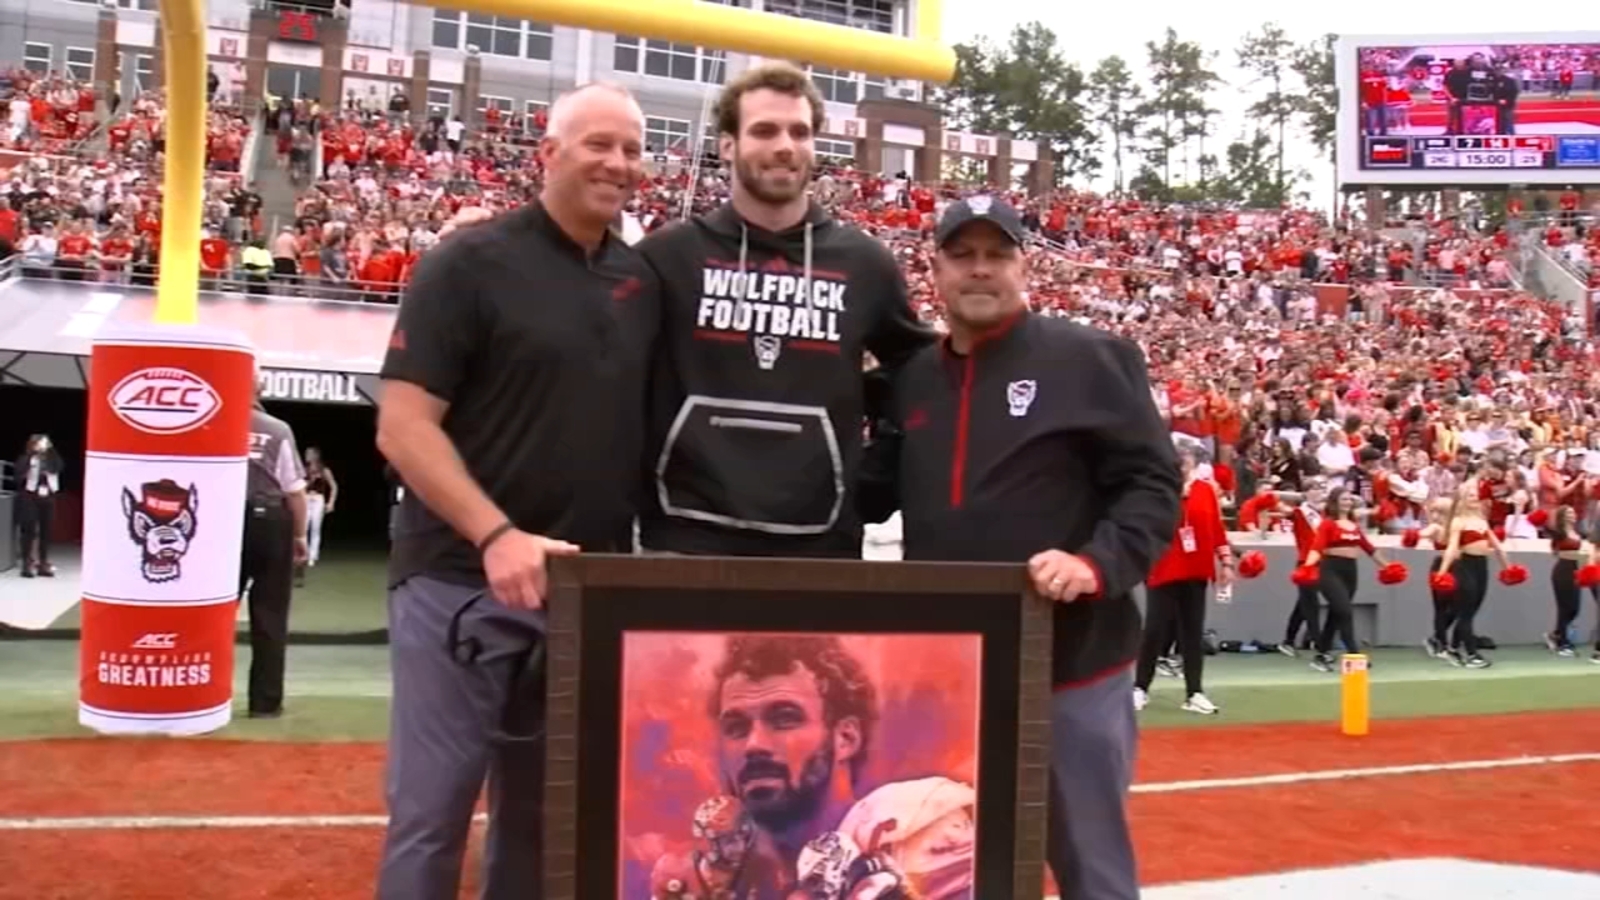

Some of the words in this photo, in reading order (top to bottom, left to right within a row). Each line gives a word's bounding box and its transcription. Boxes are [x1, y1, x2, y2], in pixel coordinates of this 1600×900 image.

[1467, 155, 1506, 164] 15:00
[703, 268, 846, 311] WOLFPACK
[697, 298, 841, 341] FOOTBALL
[124, 386, 203, 406] ACC
[133, 634, 178, 647] ACC
[98, 662, 210, 686] GREATNESS
